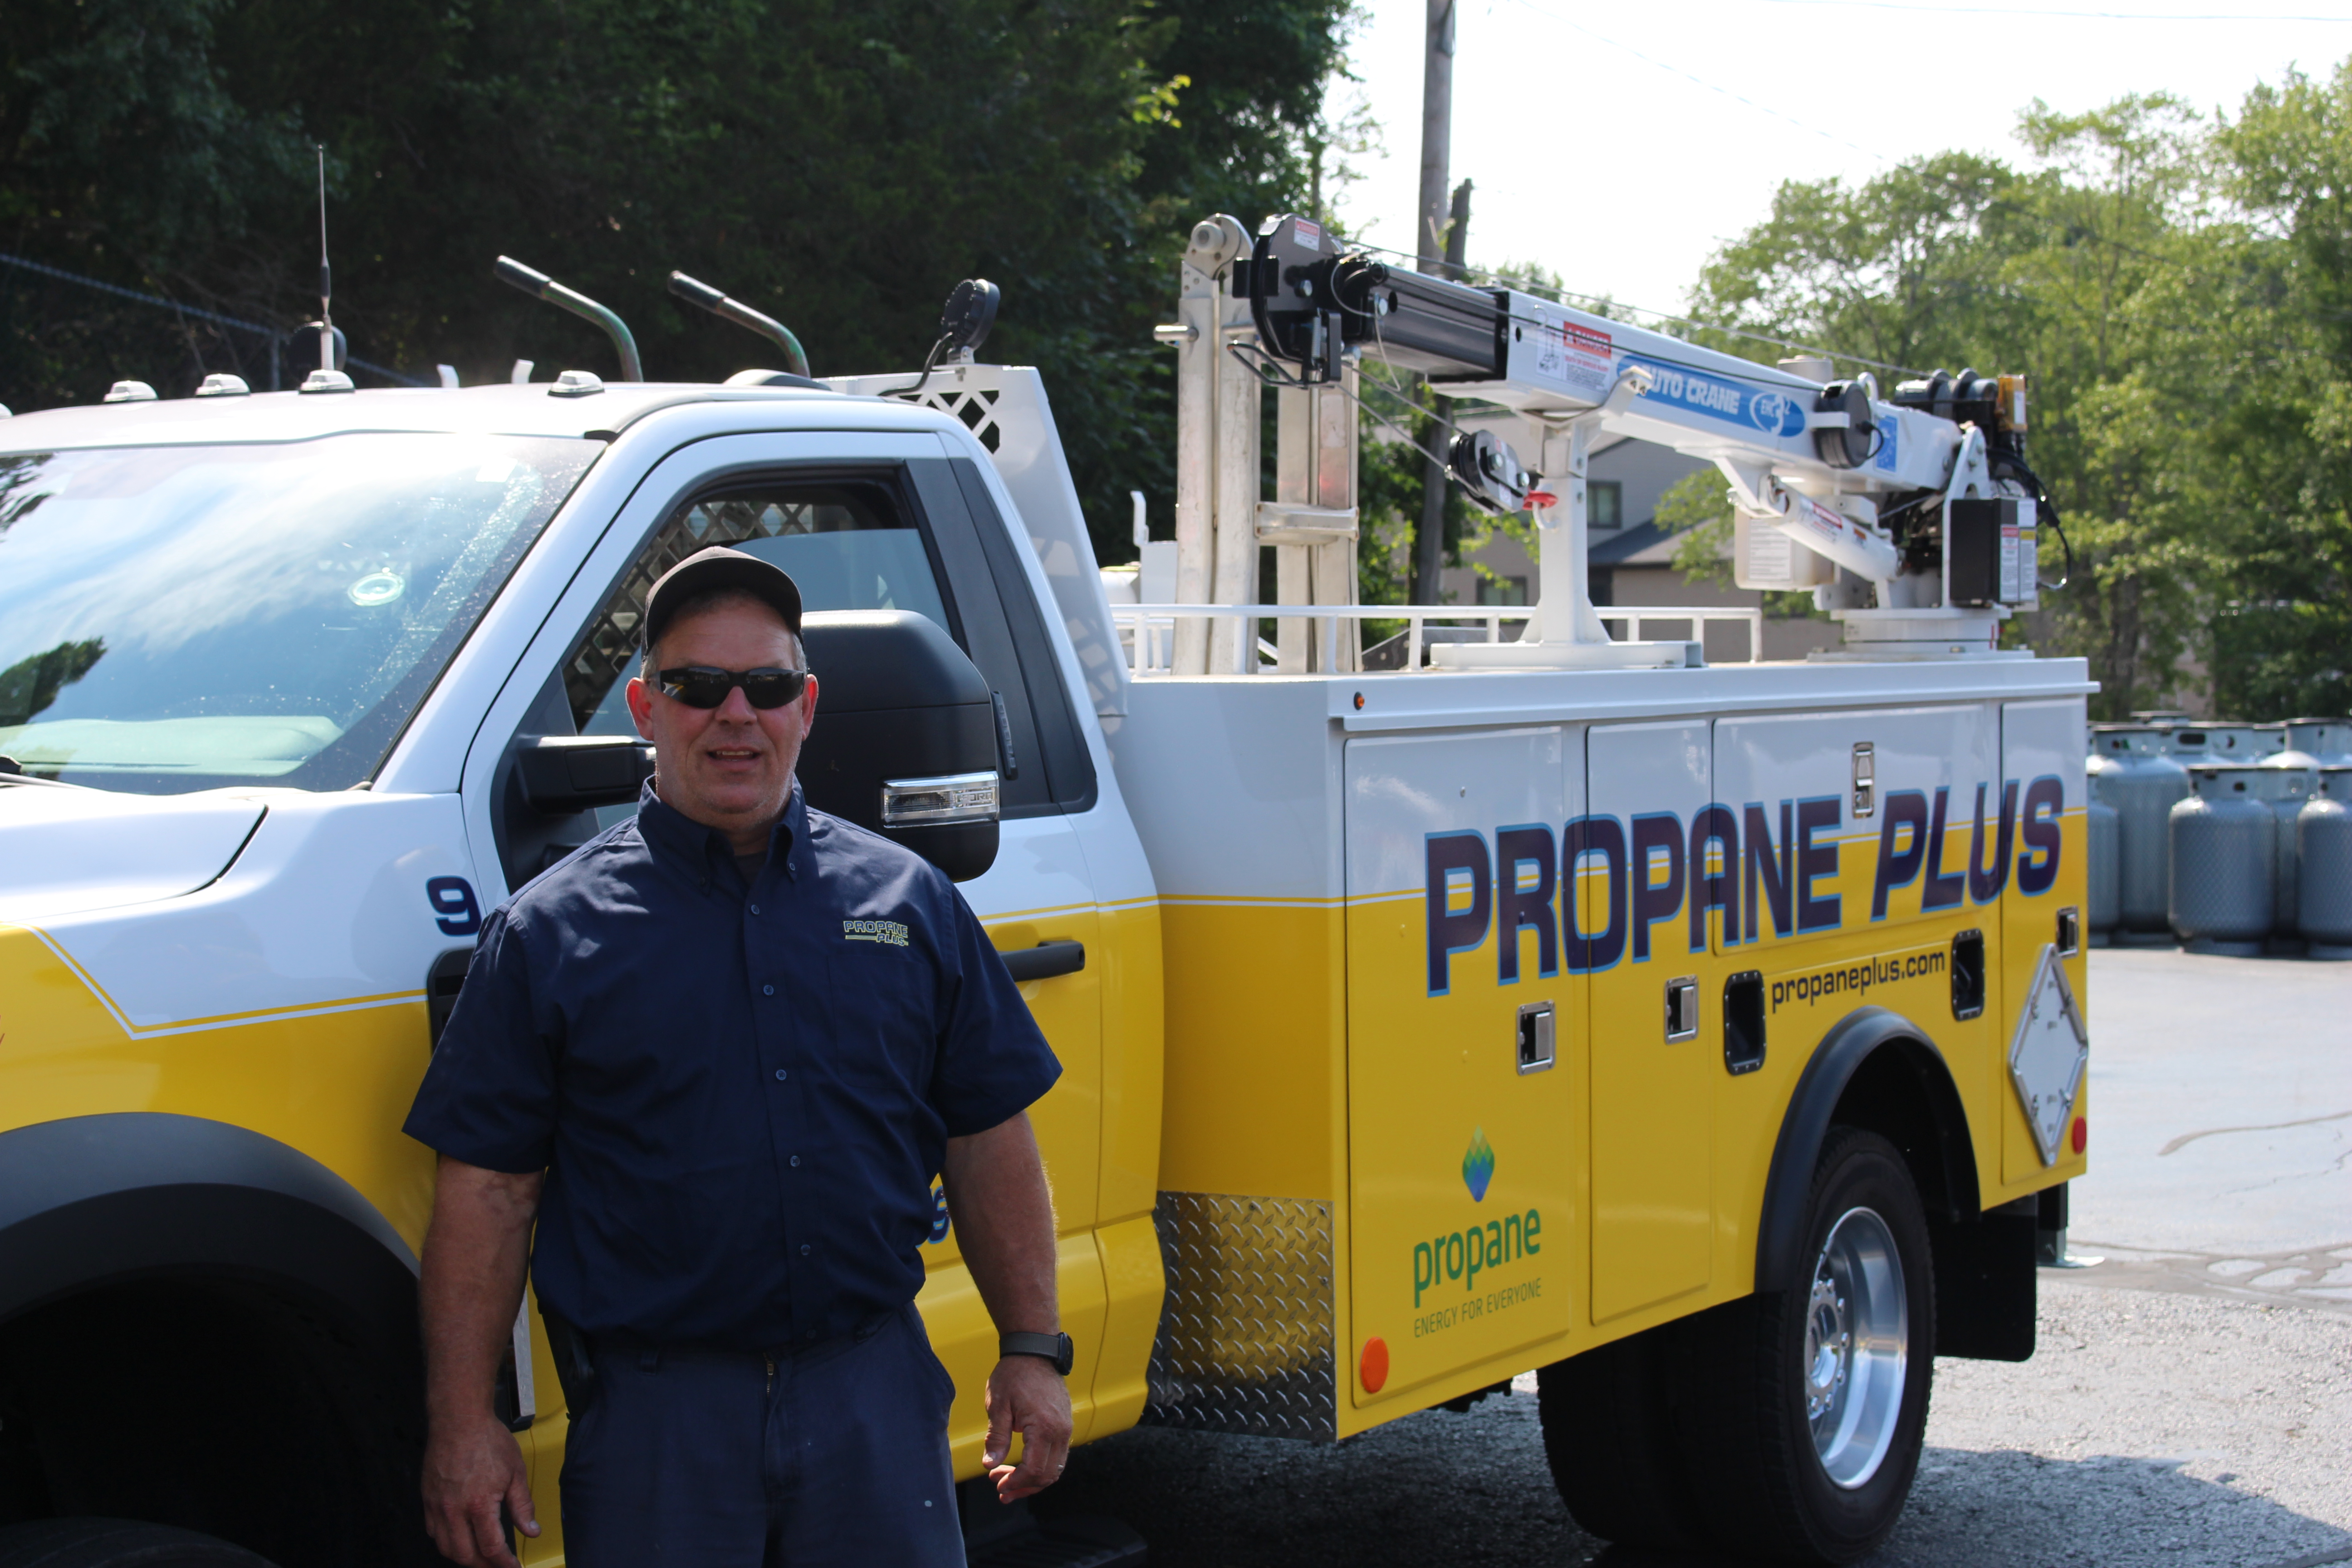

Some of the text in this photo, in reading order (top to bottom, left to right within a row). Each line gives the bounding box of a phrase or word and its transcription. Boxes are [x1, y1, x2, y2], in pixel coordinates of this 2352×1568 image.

[1686, 377, 1741, 415] CRANE
[426, 875, 482, 937] 9
[1424, 774, 2064, 998] PROPANE PLUS
[843, 920, 908, 938] PROPANE
[876, 933, 905, 947] PLUS
[1772, 951, 1945, 1014] propaneplus.com
[1414, 1208, 1541, 1308] propane
[1414, 1277, 1541, 1338] ENERGY FOR EVERYONE
